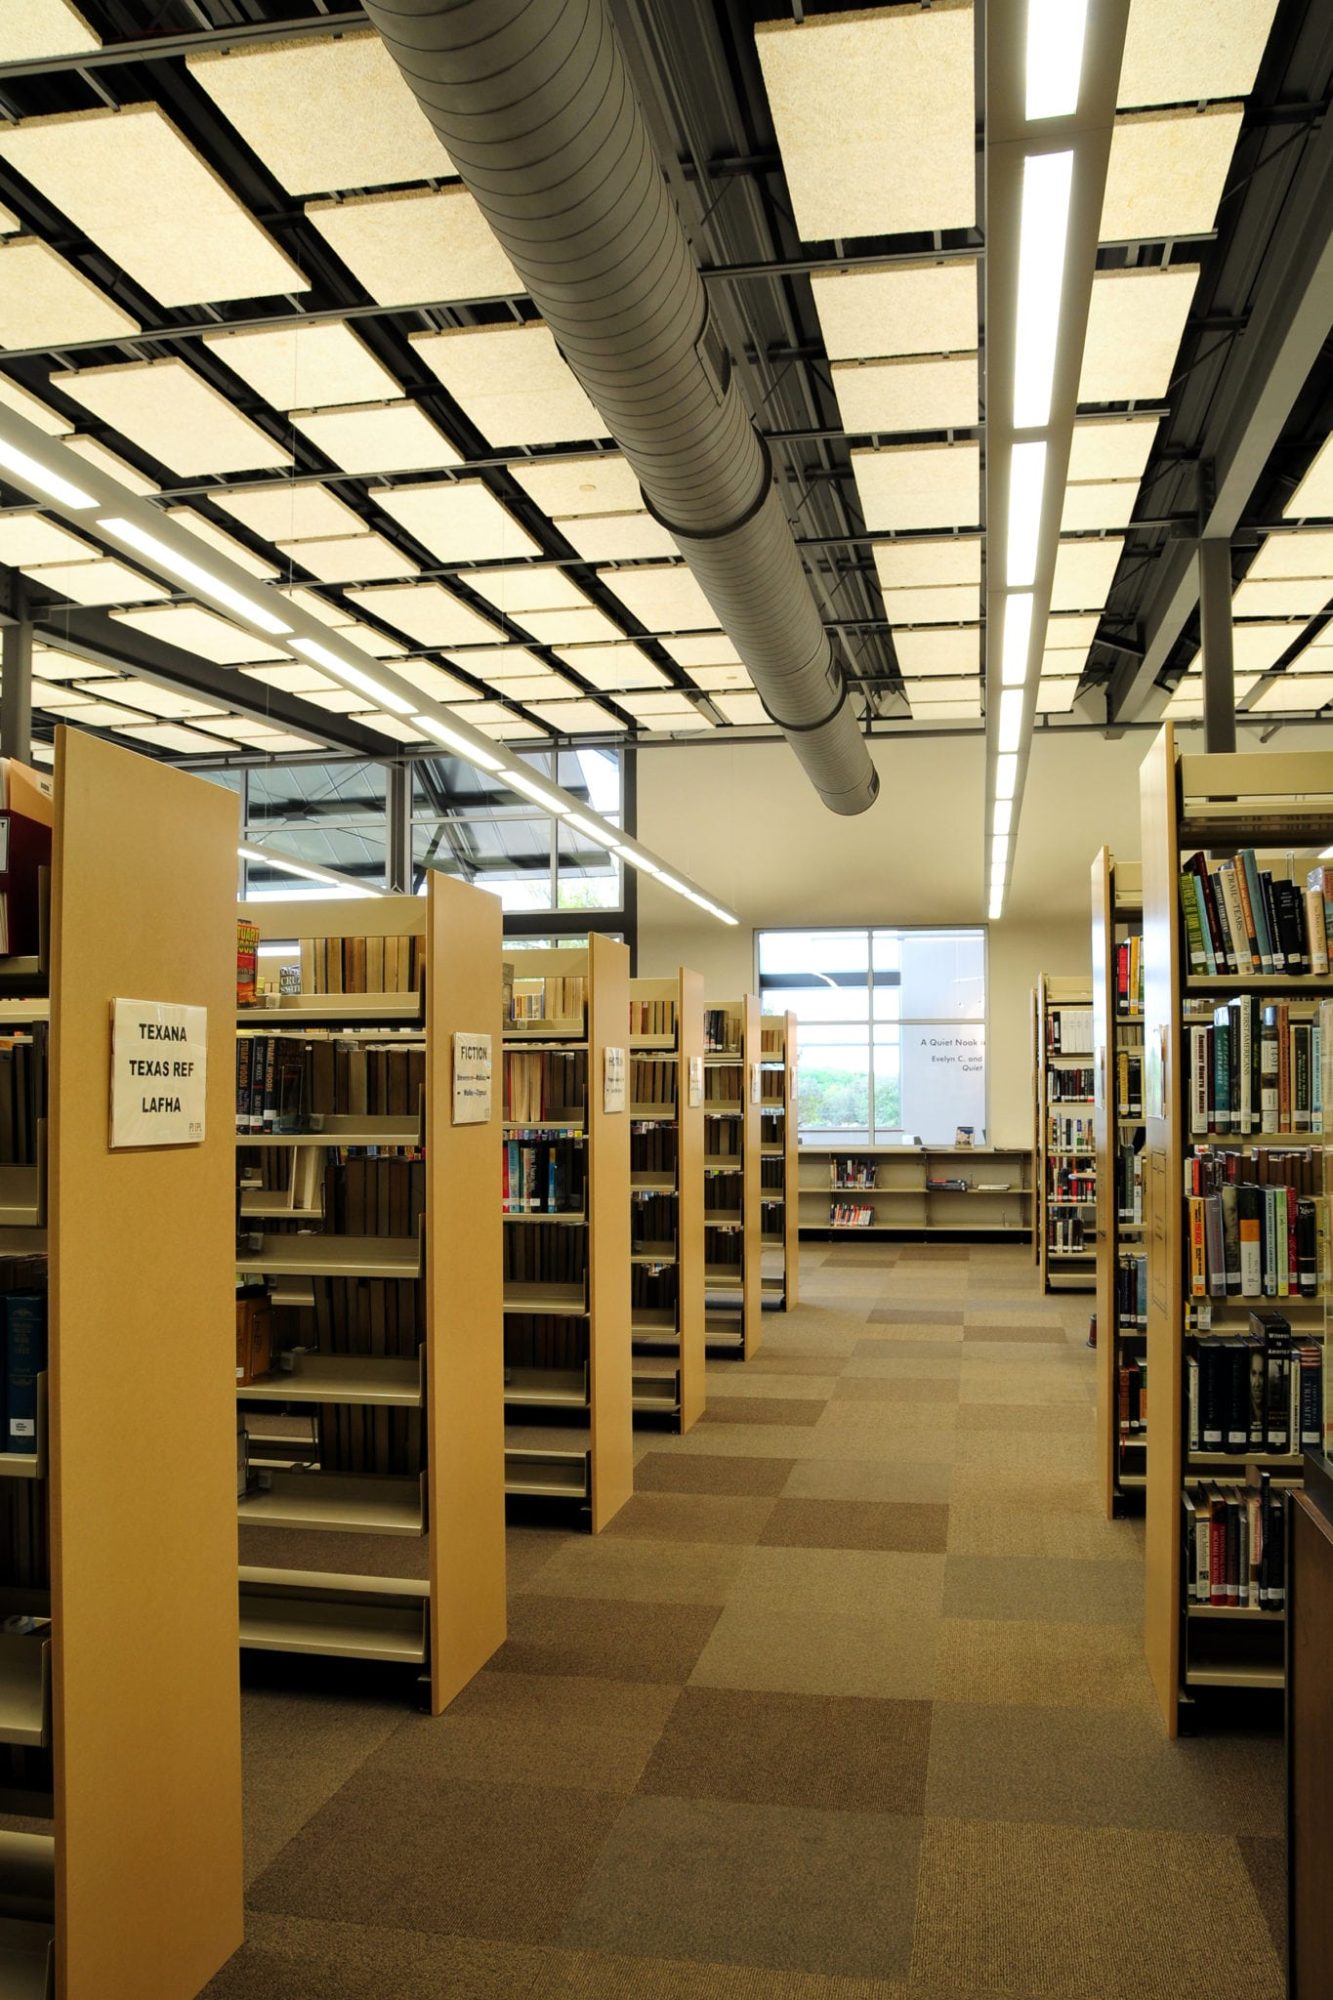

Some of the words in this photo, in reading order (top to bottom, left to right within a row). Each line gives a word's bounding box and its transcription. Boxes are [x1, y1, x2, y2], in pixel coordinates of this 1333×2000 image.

[1228, 873, 1238, 897] TRAIL
[237, 926, 259, 942] TUART
[139, 1023, 187, 1042] TEXANA
[240, 1040, 249, 1063] STUART
[267, 1040, 275, 1061] STUART
[461, 1046, 487, 1060] FICTION
[129, 1060, 170, 1077] TEXAS
[173, 1062, 194, 1077] REF
[239, 1064, 248, 1087] WOODS
[265, 1063, 273, 1091] WOODS
[142, 1097, 181, 1112] LAFHA
